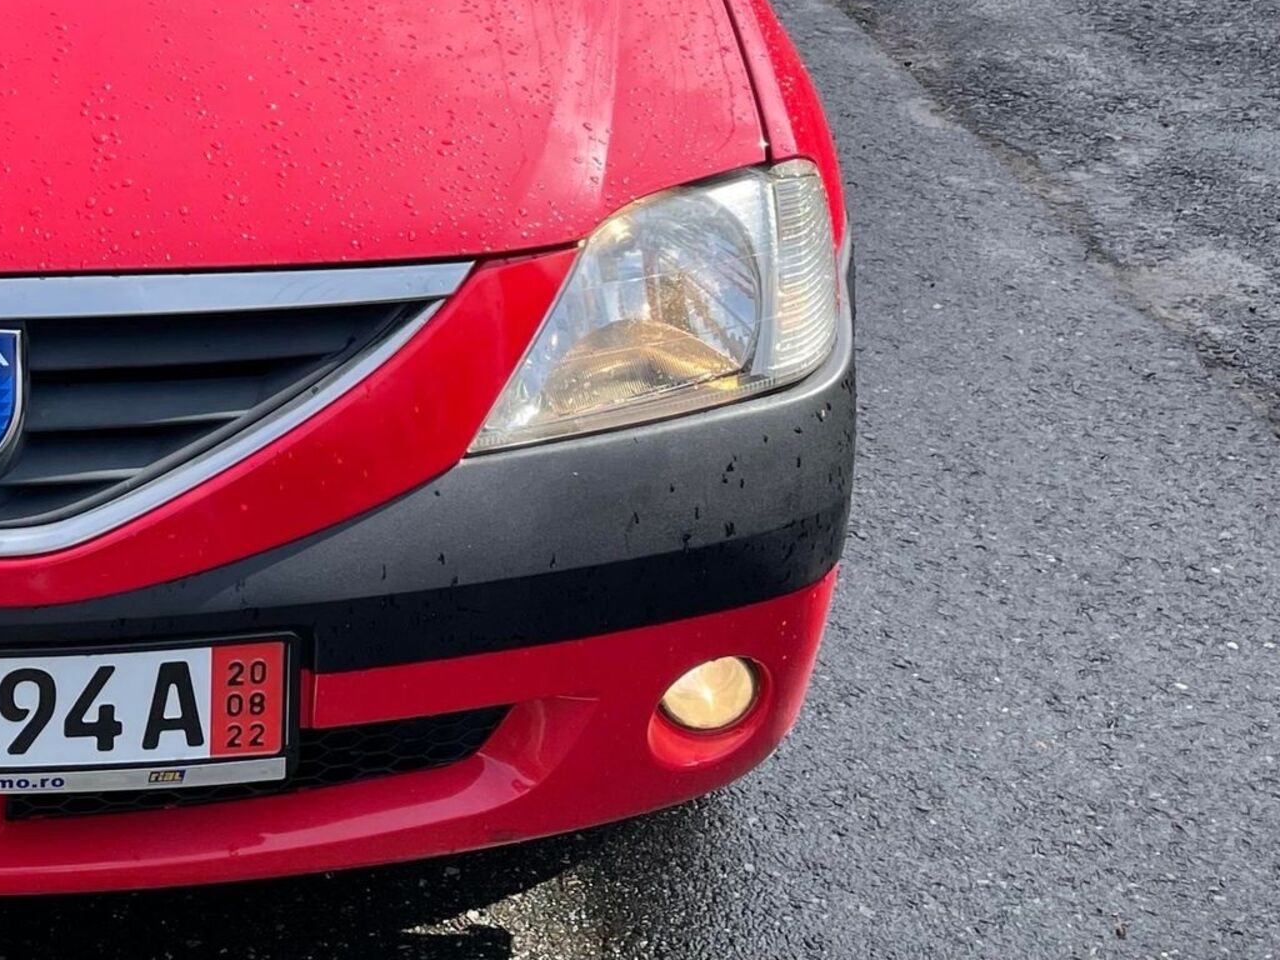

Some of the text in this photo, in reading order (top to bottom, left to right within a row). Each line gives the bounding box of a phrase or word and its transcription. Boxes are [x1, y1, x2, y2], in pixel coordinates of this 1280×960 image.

[227, 661, 267, 686] 20
[142, 661, 205, 751] A
[226, 692, 265, 717] 08
[226, 724, 265, 748] 22
